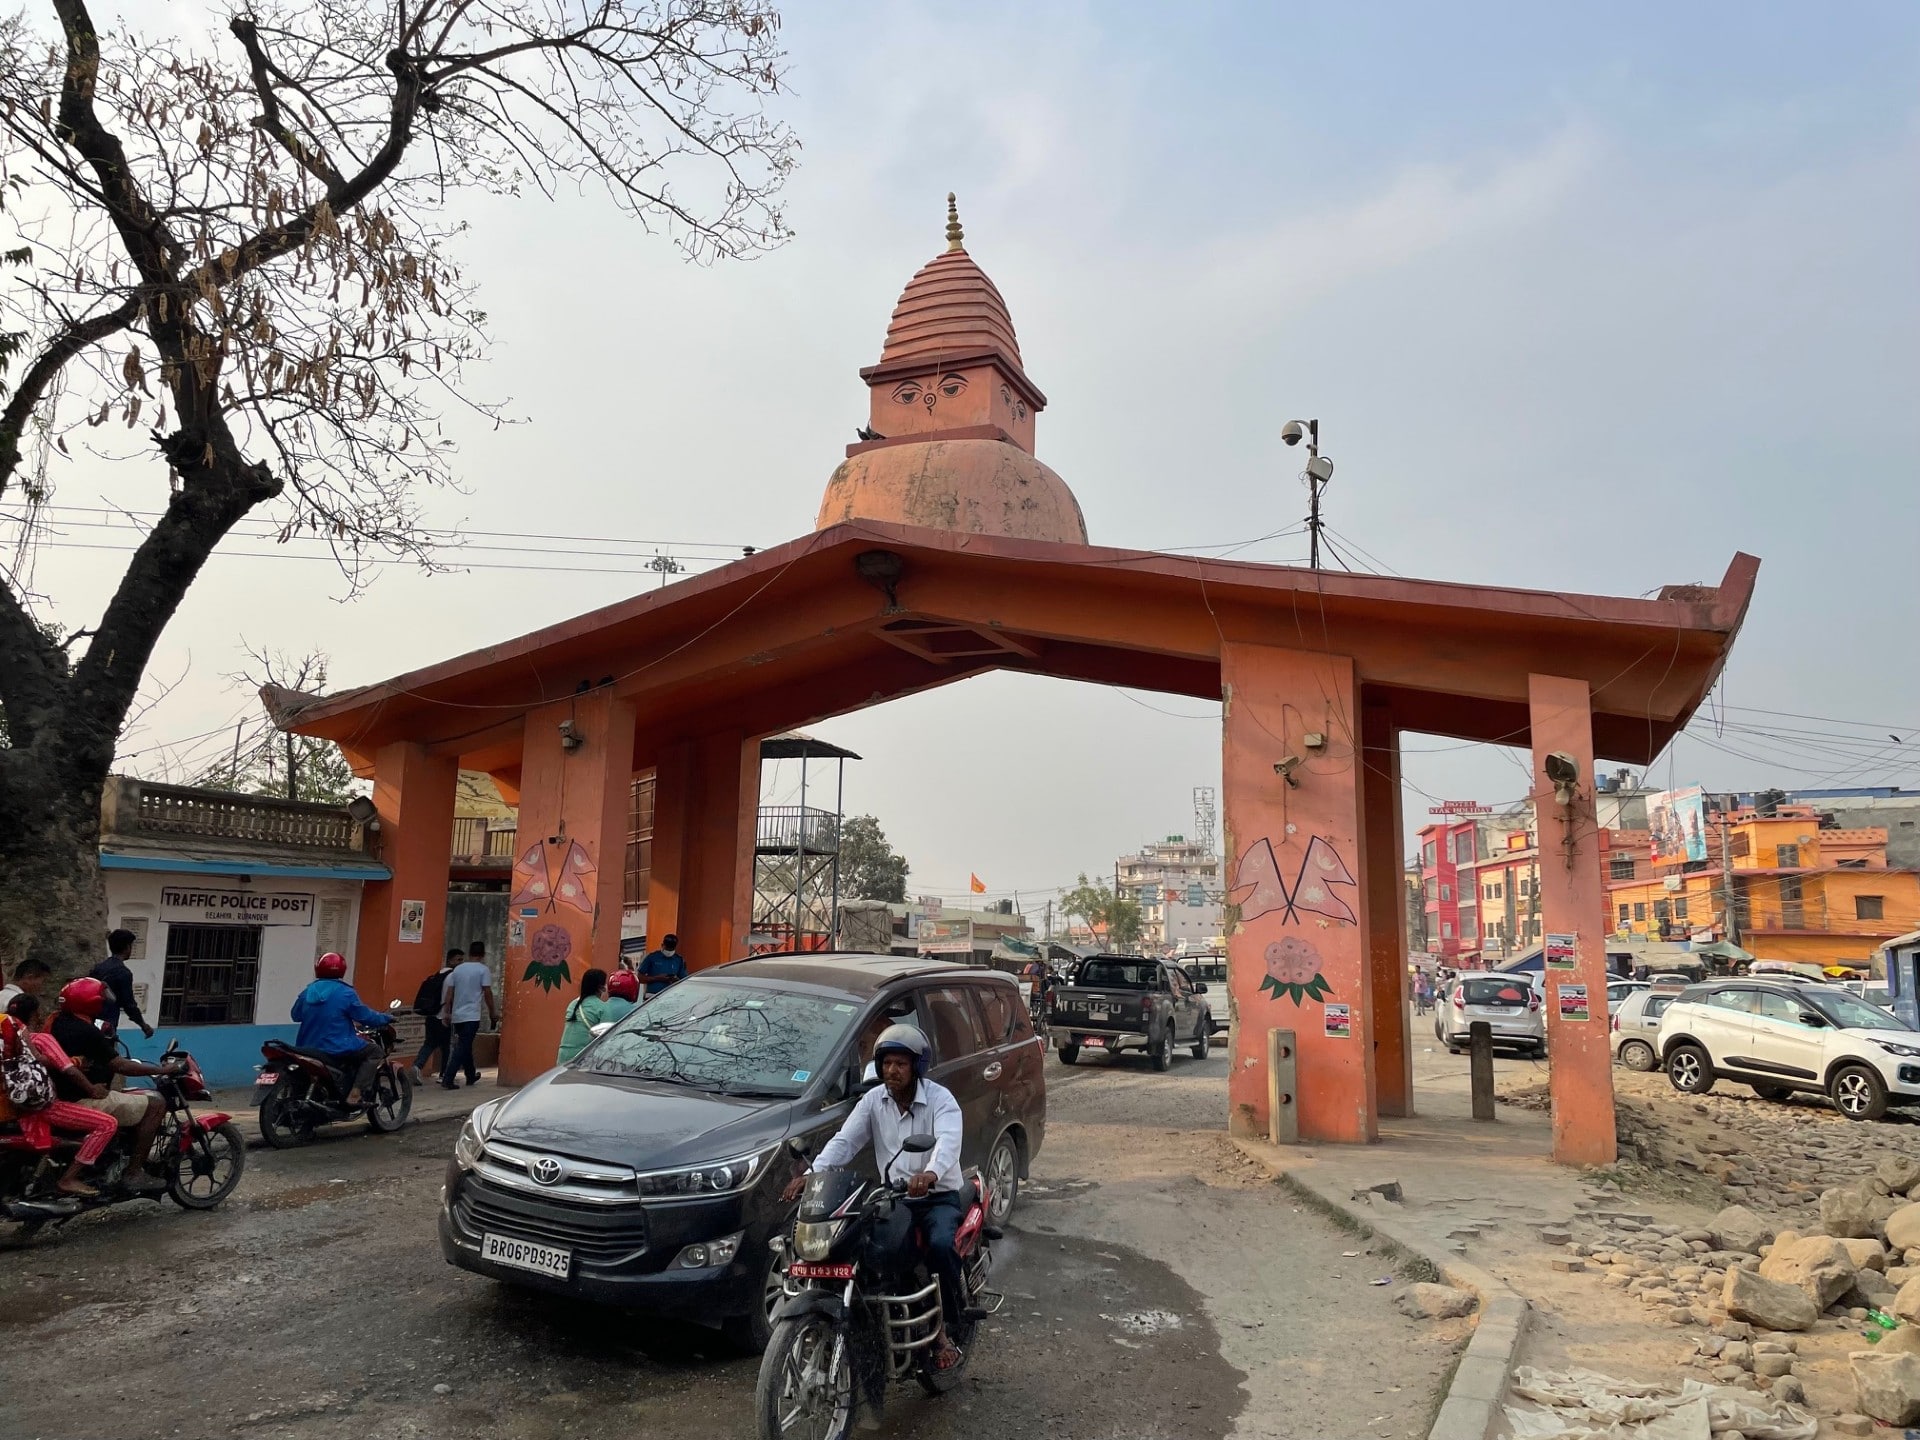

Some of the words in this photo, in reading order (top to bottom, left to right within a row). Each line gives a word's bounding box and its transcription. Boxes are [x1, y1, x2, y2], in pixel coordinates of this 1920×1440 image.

[164, 892, 216, 907] TRAFFIC
[220, 895, 266, 910] POLICE
[271, 898, 309, 911] POST
[1071, 1001, 1122, 1014] ISUZU
[490, 1239, 569, 1271] BR06PD9325
